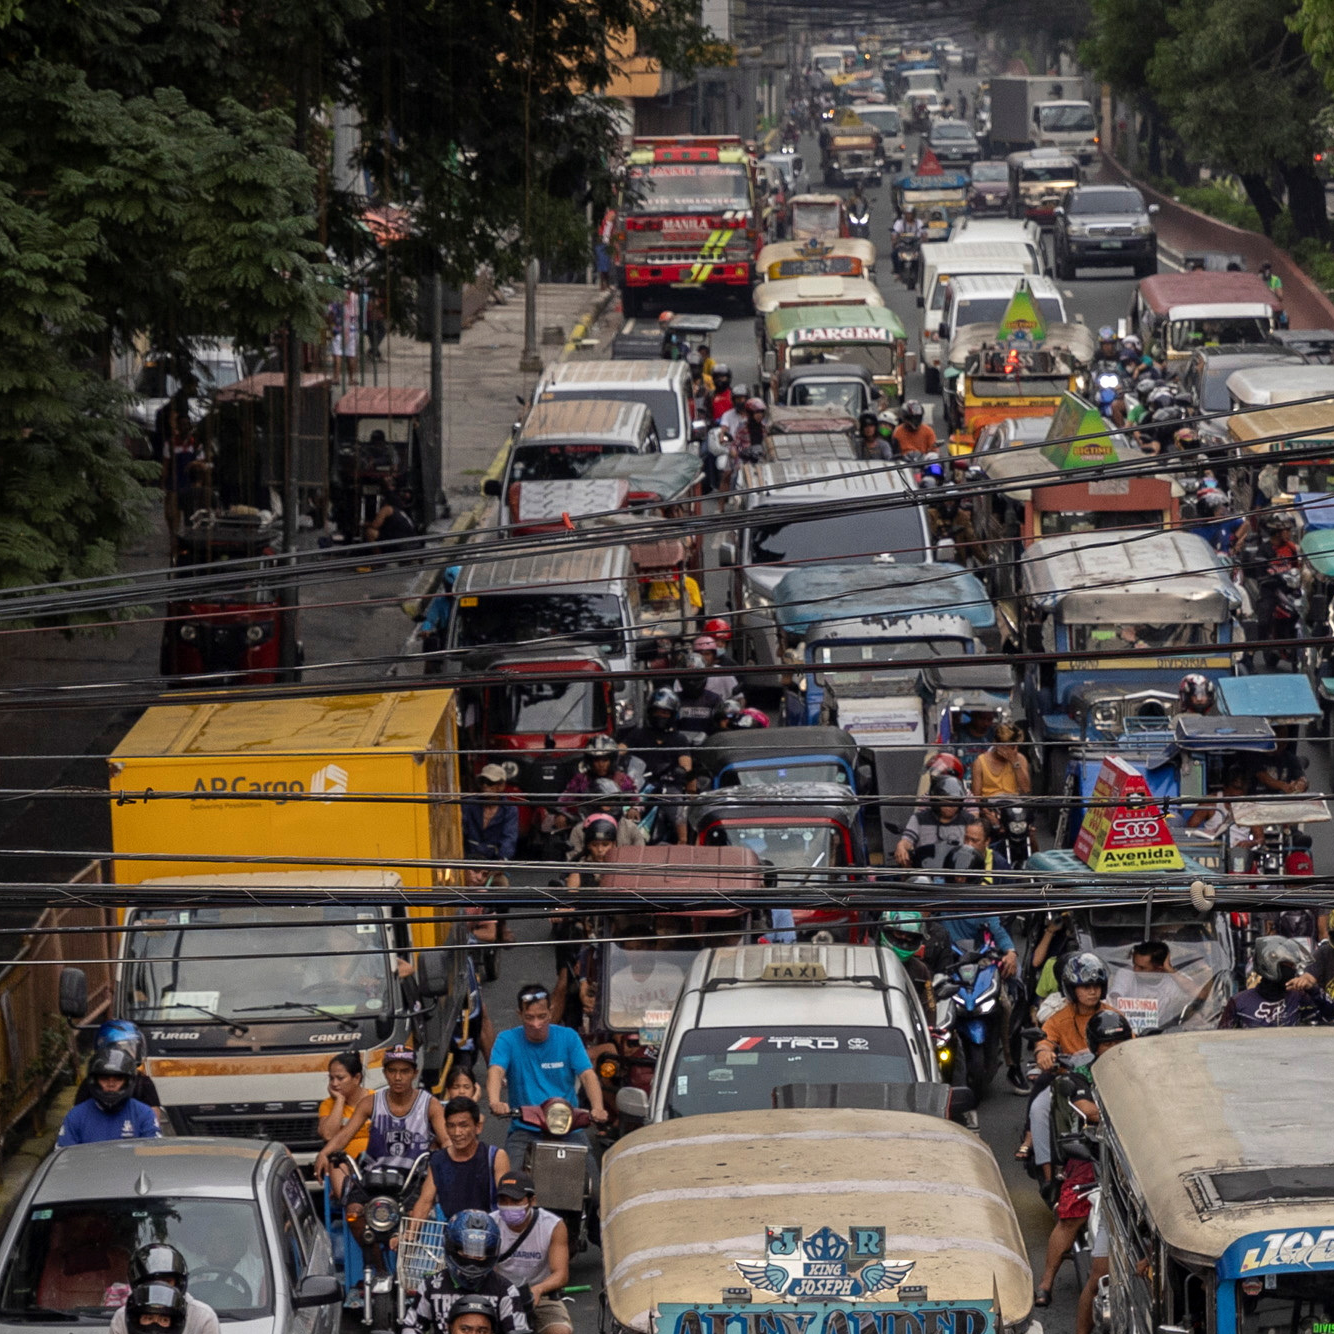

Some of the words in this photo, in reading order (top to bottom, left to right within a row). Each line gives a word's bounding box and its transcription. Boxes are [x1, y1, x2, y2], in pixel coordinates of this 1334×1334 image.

[798, 328, 887, 341] LARGEM
[1104, 849, 1174, 862] Avenida
[770, 966, 818, 978] TAXI
[309, 1032, 362, 1043] CANTER
[768, 1039, 839, 1049] TRD
[387, 1131, 412, 1144] NETS
[770, 1231, 796, 1256] J
[855, 1231, 881, 1256] R
[809, 1264, 841, 1276] KING
[795, 1280, 853, 1295] JOSEPH
